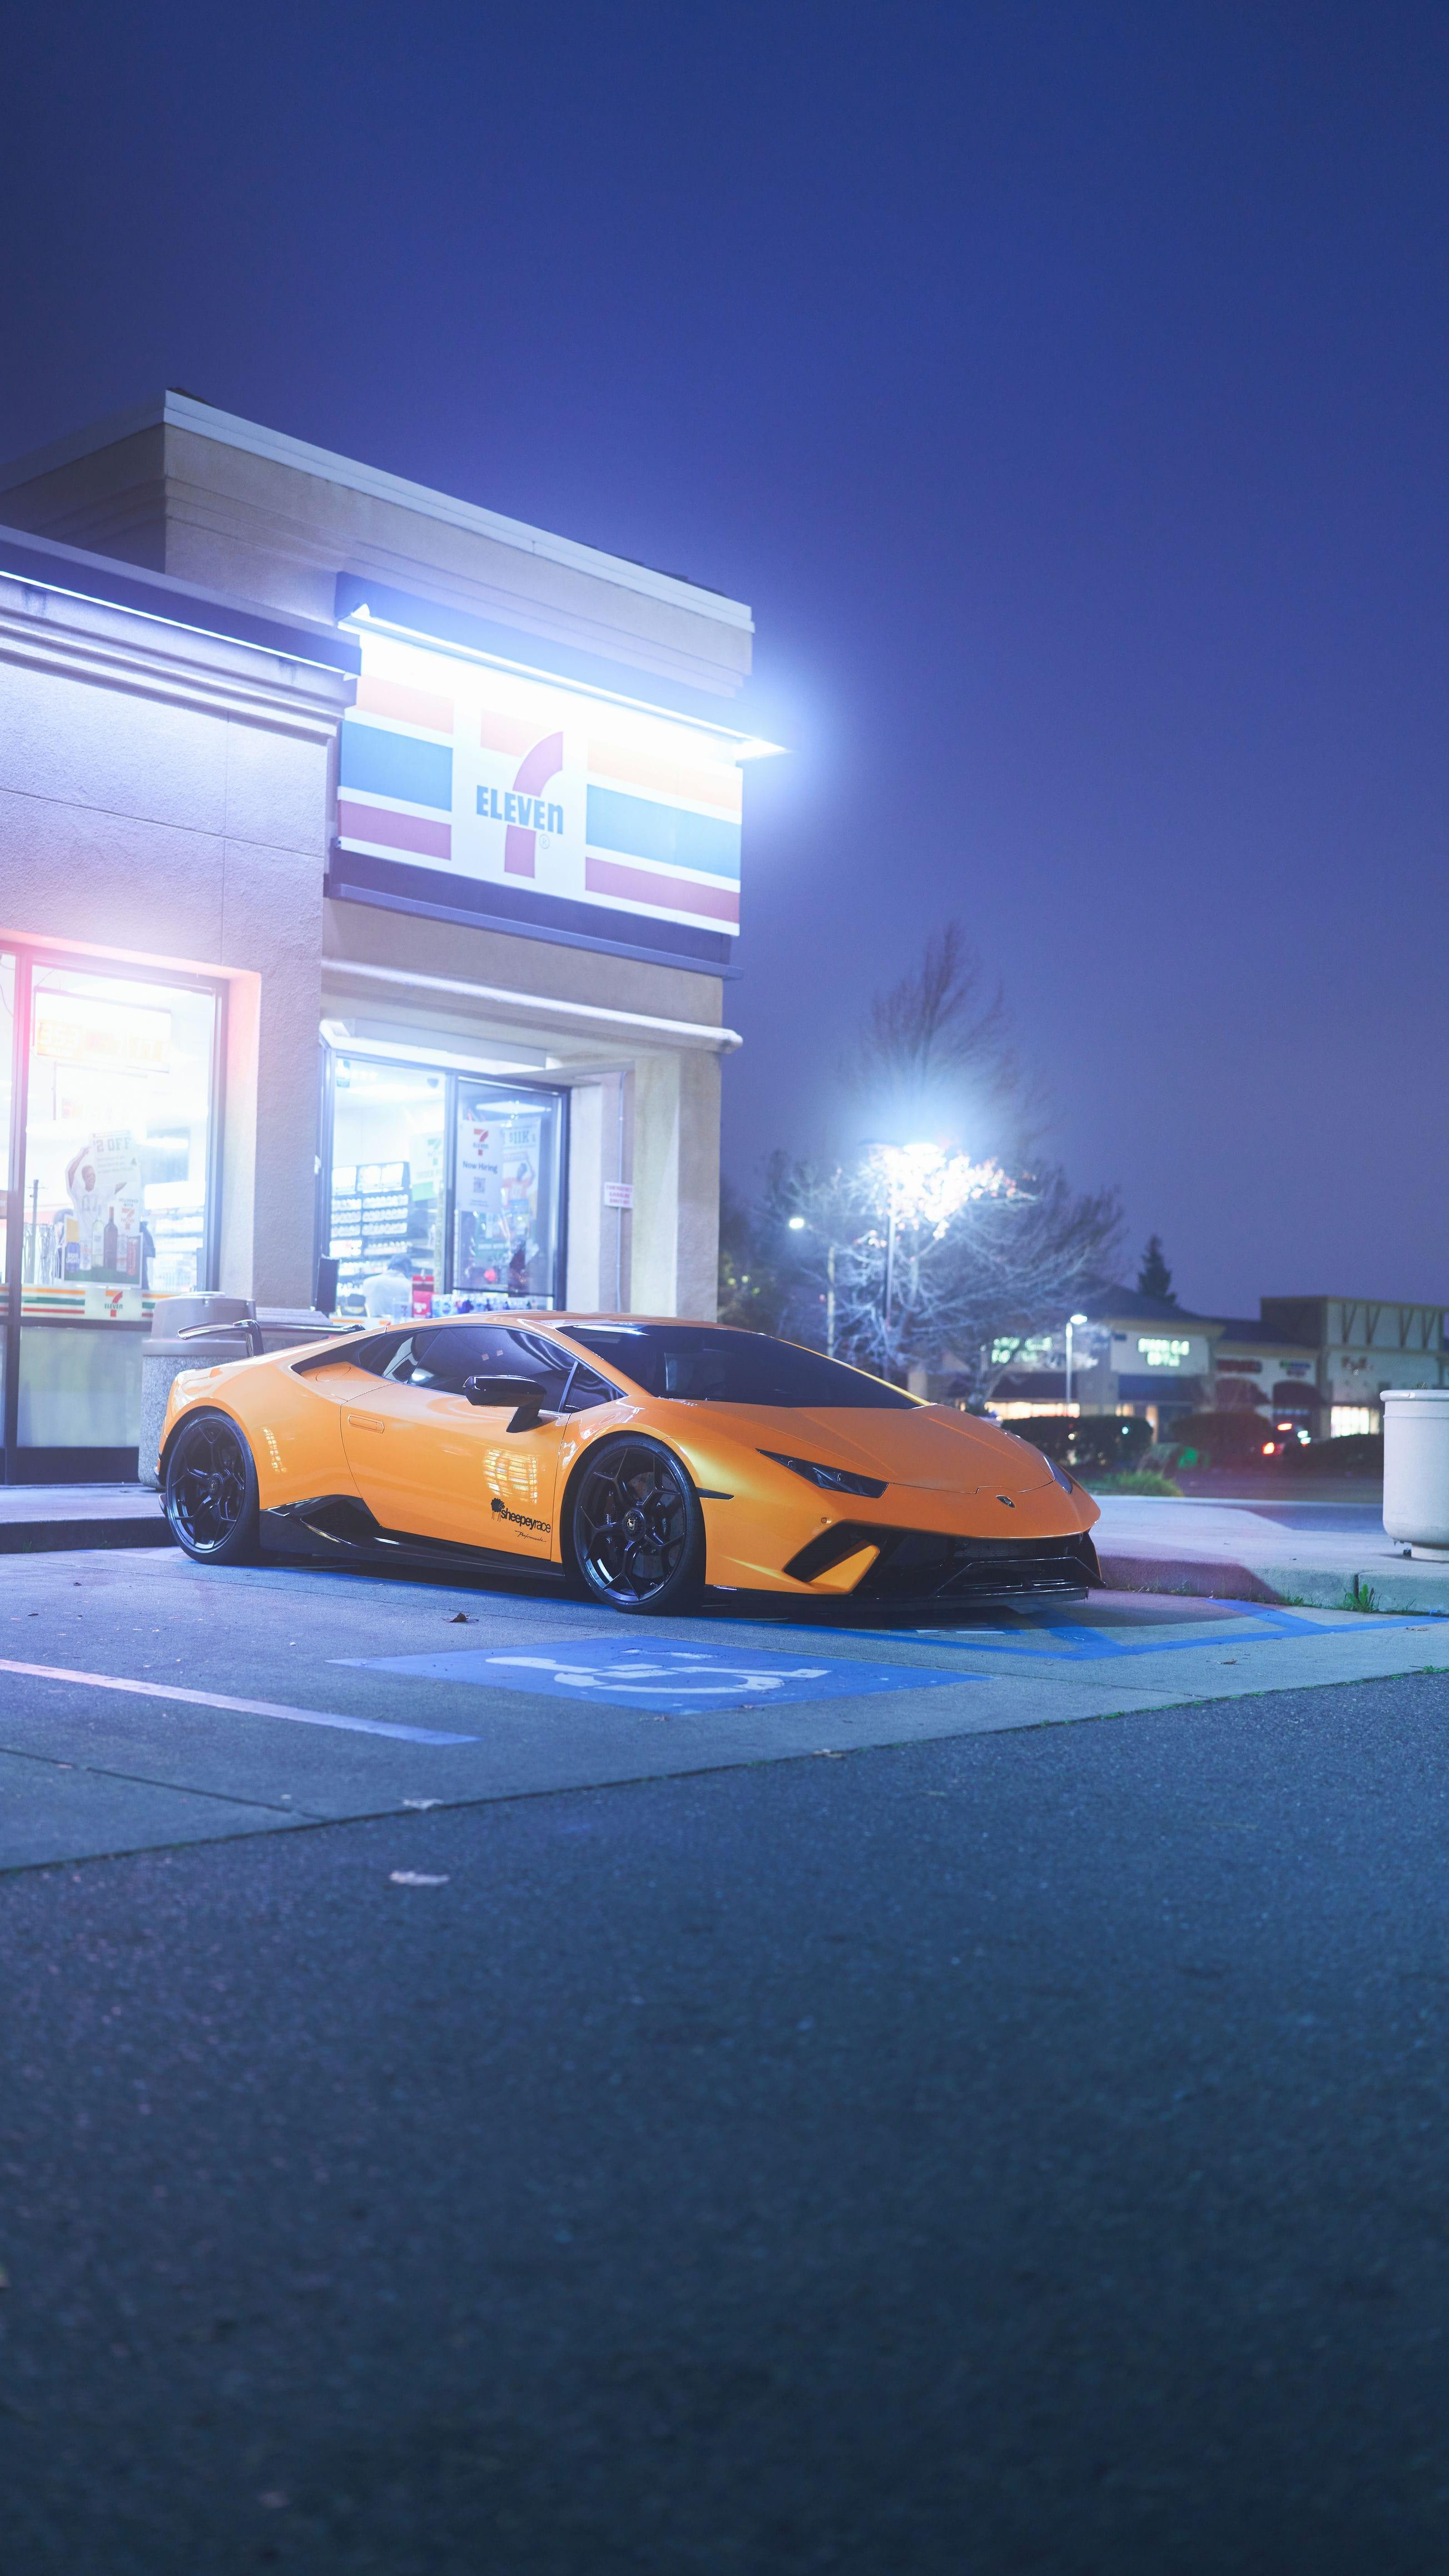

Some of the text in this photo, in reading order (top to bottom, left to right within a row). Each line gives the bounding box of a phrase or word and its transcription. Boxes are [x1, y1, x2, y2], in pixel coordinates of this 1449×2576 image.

[481, 708, 563, 878] 7
[107, 1137, 131, 1152] OFF
[463, 1160, 498, 1174] Now Hiring
[106, 1289, 123, 1317] 7
[500, 1507, 551, 1533] sheepeyrace
